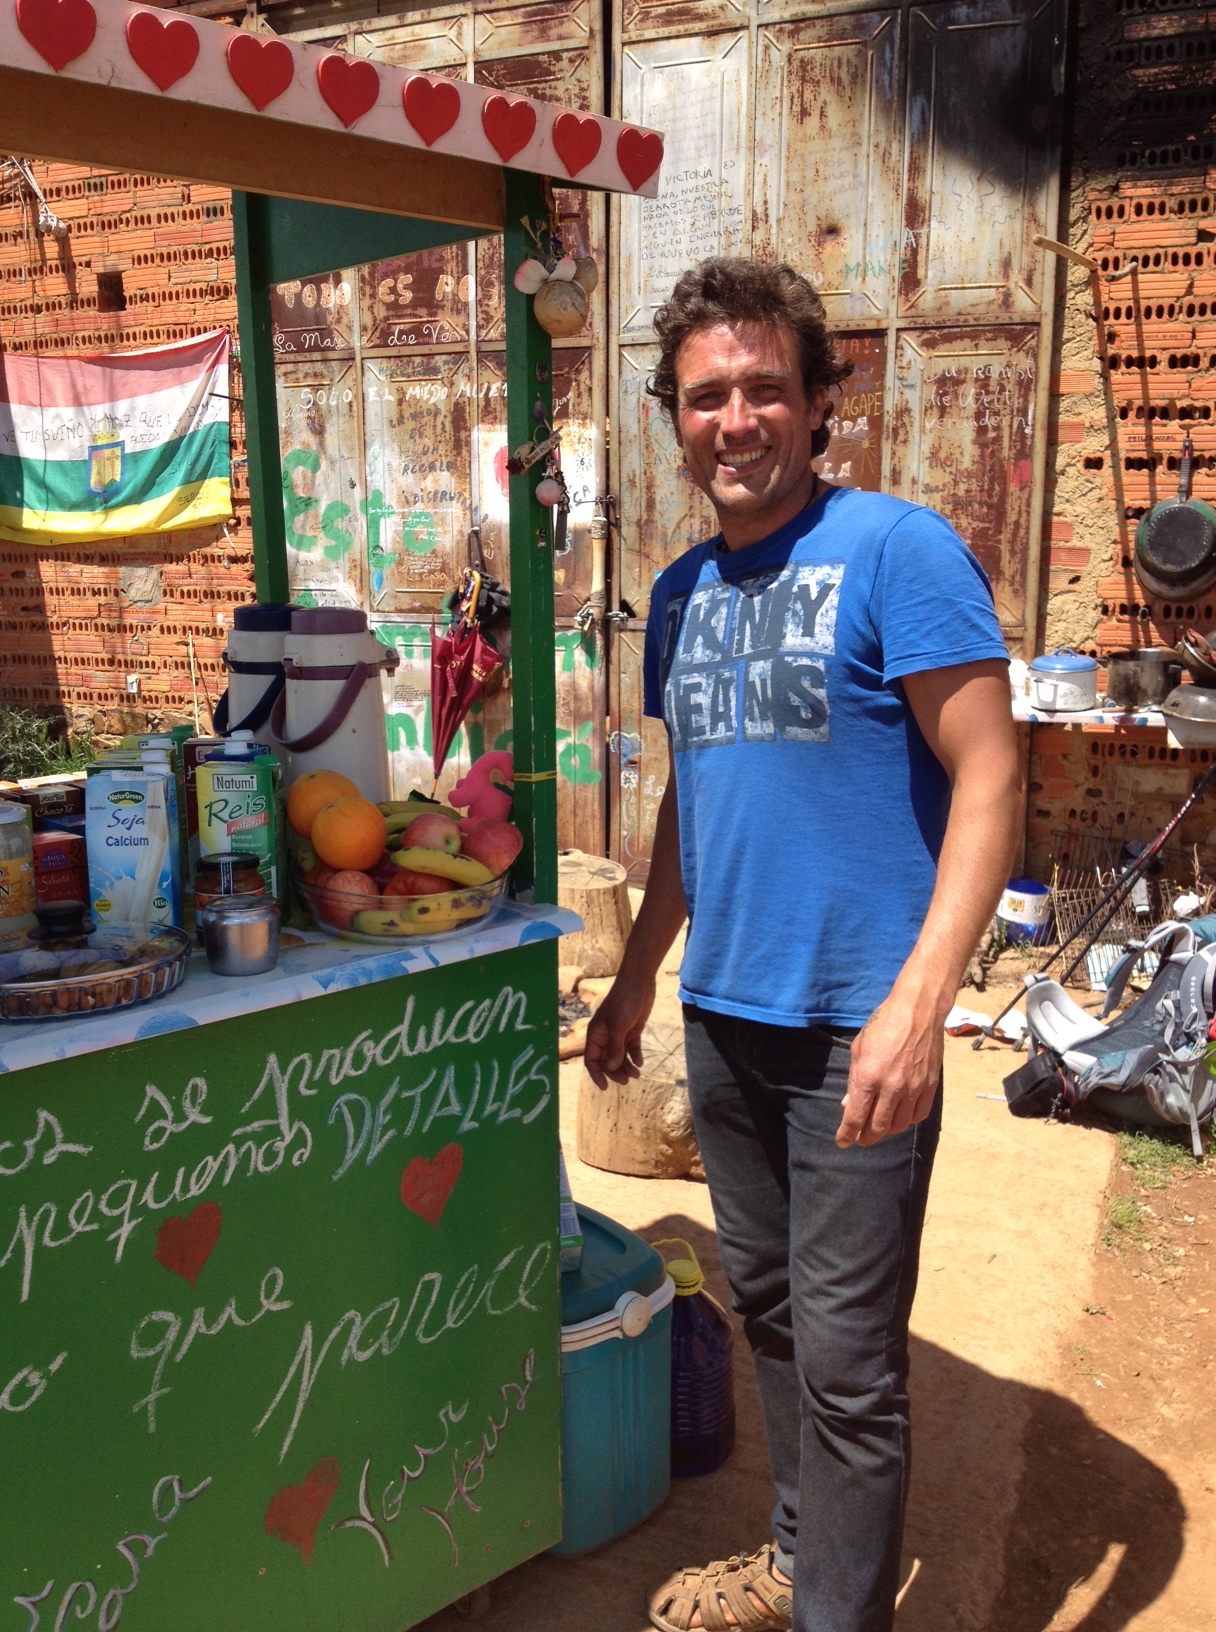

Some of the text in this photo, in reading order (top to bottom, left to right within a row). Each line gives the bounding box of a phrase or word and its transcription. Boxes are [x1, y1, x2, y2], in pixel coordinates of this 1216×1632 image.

[665, 167, 713, 185] VICTORIA
[845, 256, 911, 279] MAKE
[276, 280, 351, 308] TODO
[379, 274, 413, 304] ES
[274, 332, 297, 354] La
[926, 358, 957, 382] Du
[300, 388, 353, 409] SOLO
[368, 387, 395, 402] EL
[841, 391, 882, 418] AGAPE
[925, 383, 1013, 409] die Welt
[216, 775, 255, 790] Natumi
[108, 791, 143, 801] NaturGreen
[107, 808, 147, 831] Soja
[204, 794, 267, 828] Reis
[230, 813, 266, 832] natural
[105, 835, 149, 847] Calcium
[327, 1043, 552, 1183] DETALLES
[130, 1266, 294, 1434] que
[253, 1240, 552, 1465] parece
